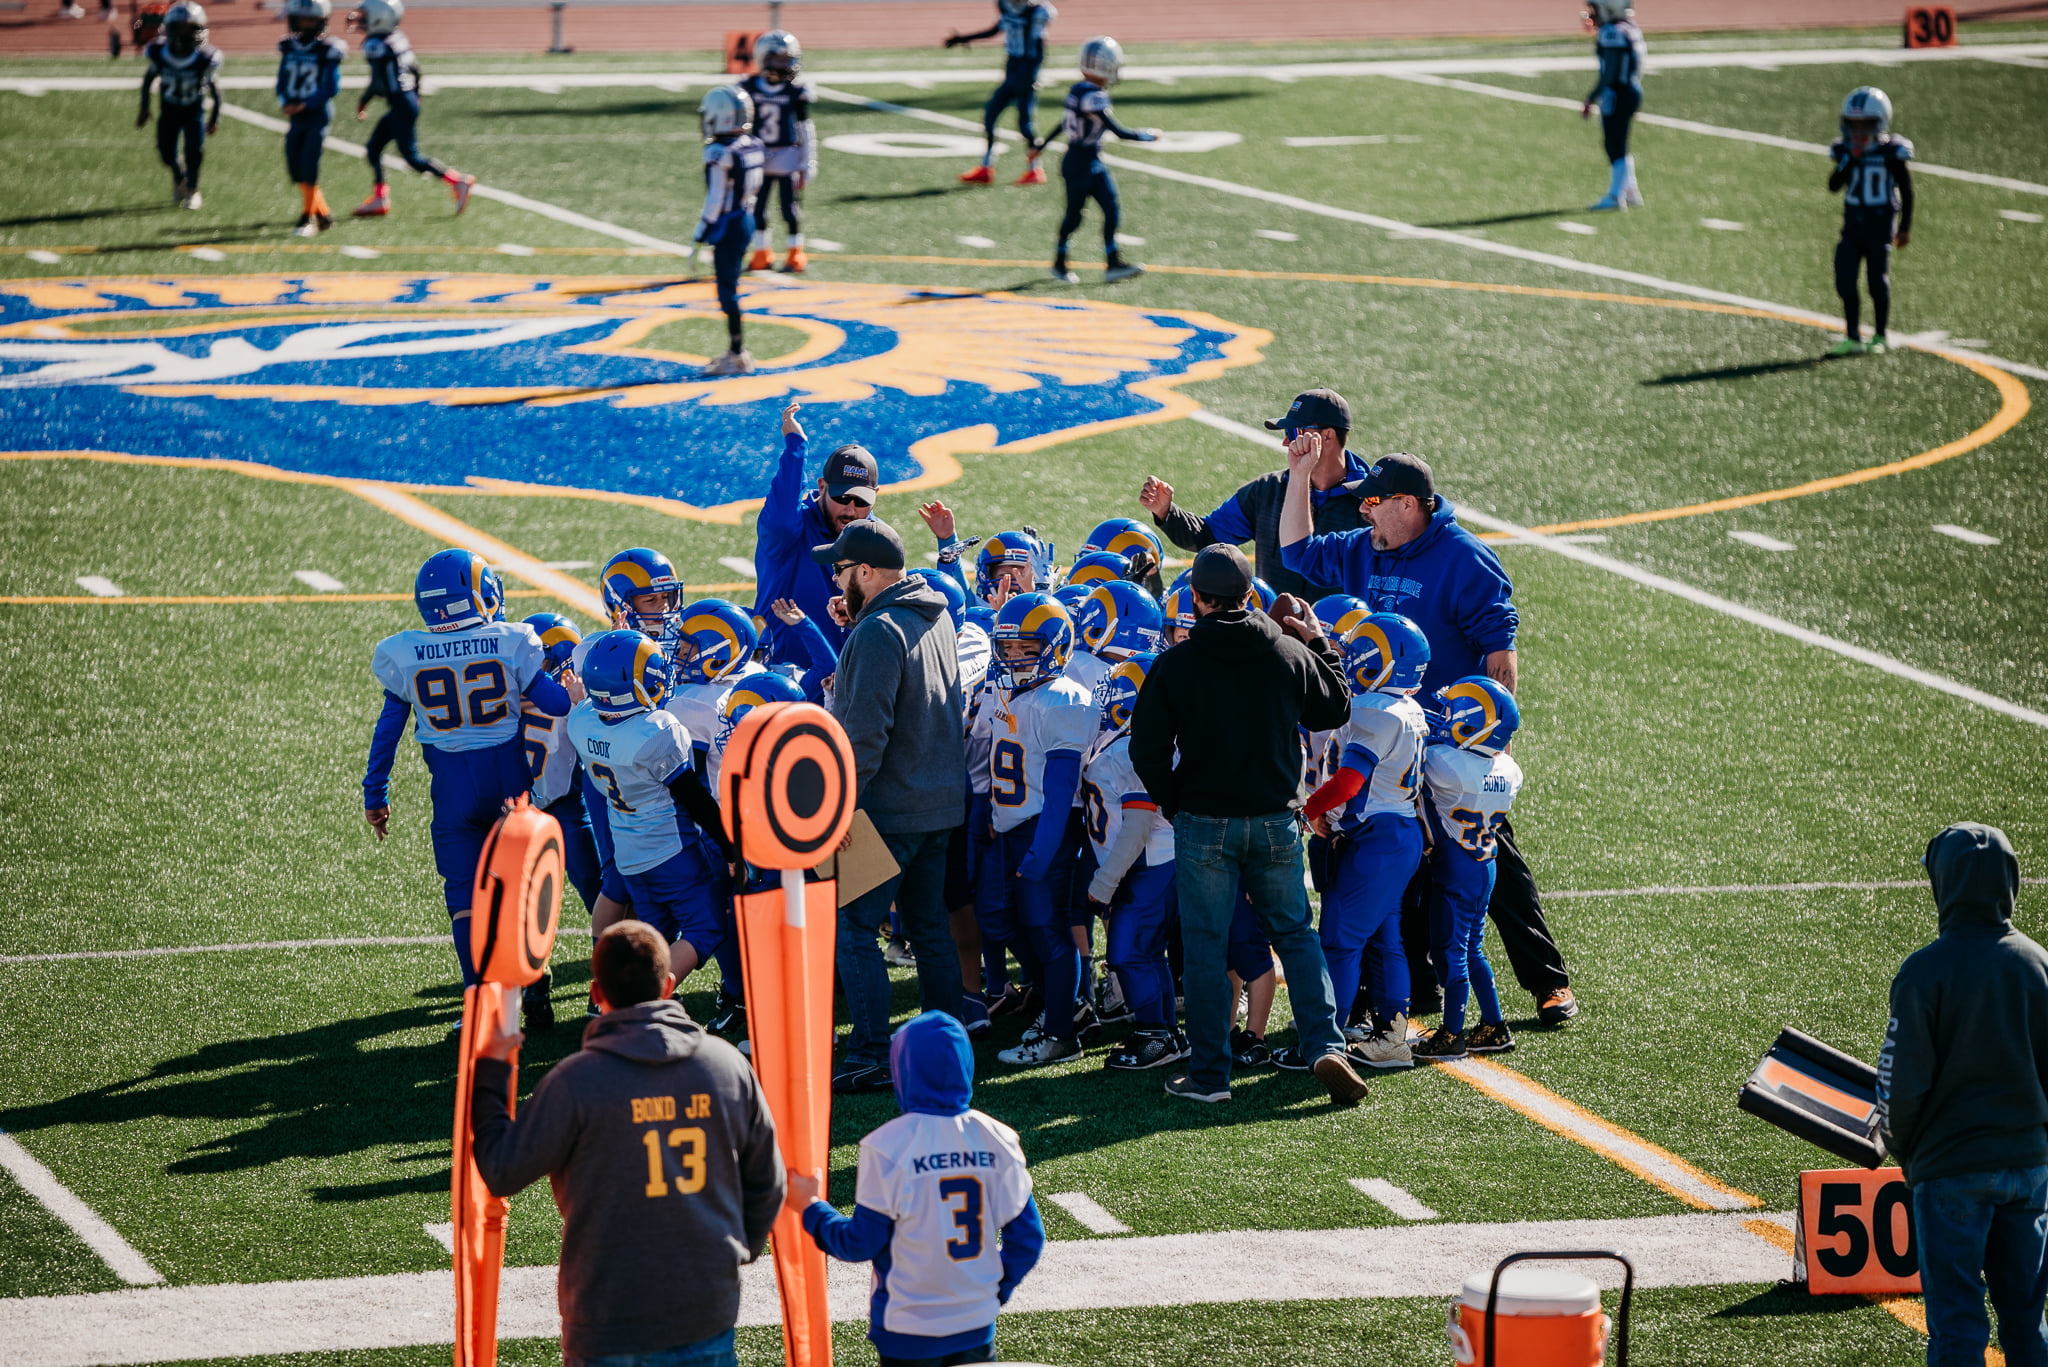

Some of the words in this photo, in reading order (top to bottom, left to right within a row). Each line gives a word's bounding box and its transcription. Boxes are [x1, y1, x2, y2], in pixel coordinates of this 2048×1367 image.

[1913, 10, 1951, 43] 30
[758, 104, 781, 143] 3
[414, 638, 499, 661] WOLVERTON
[413, 658, 509, 732] 92
[587, 738, 611, 759] COOK
[992, 738, 1028, 808] 9
[1483, 775, 1506, 793] BOND
[630, 1096, 676, 1124] BOND
[685, 1093, 711, 1119] JR
[643, 1127, 707, 1197] 13
[939, 1175, 984, 1262] 3
[1816, 1181, 1920, 1277] 50
